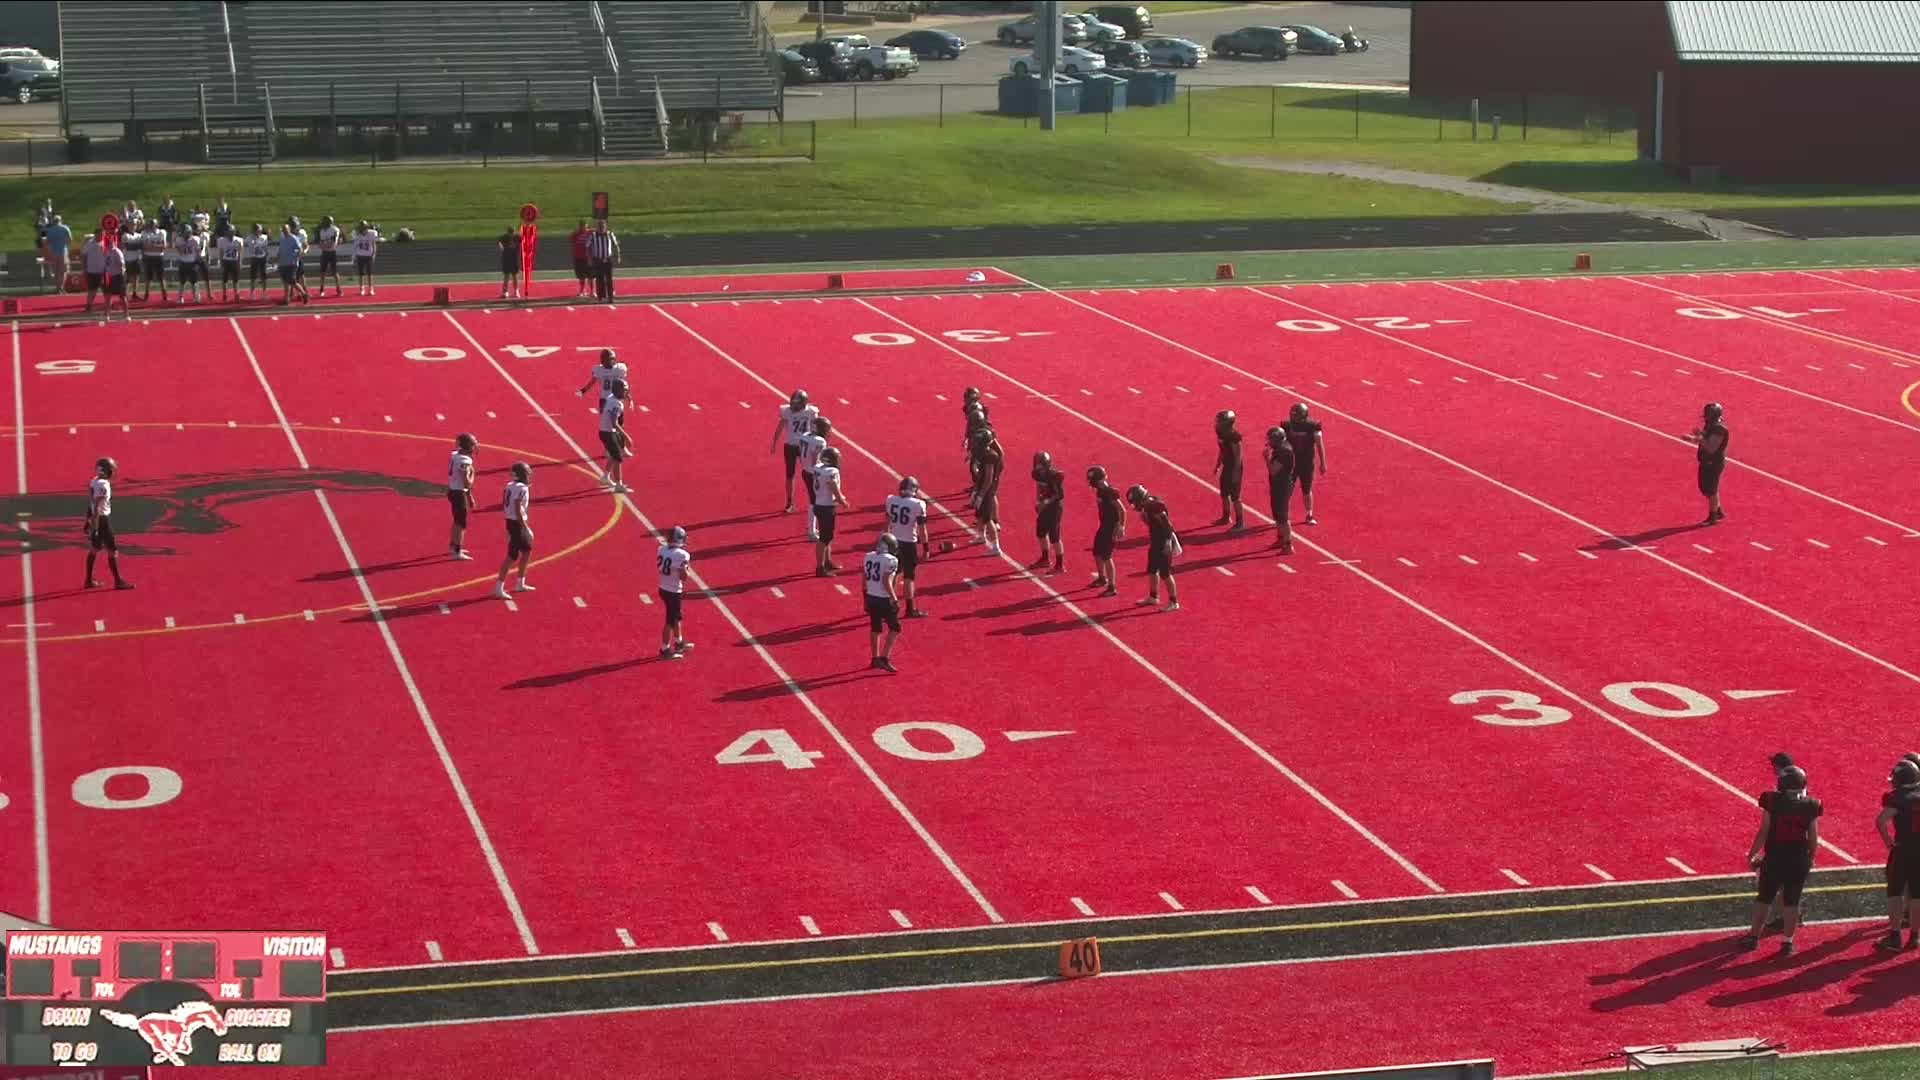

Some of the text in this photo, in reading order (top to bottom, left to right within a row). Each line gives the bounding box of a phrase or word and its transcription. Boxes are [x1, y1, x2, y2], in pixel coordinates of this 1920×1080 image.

[890, 503, 910, 526] 56
[657, 555, 672, 576] 28
[865, 560, 881, 582] 33
[1069, 942, 1096, 973] 40
